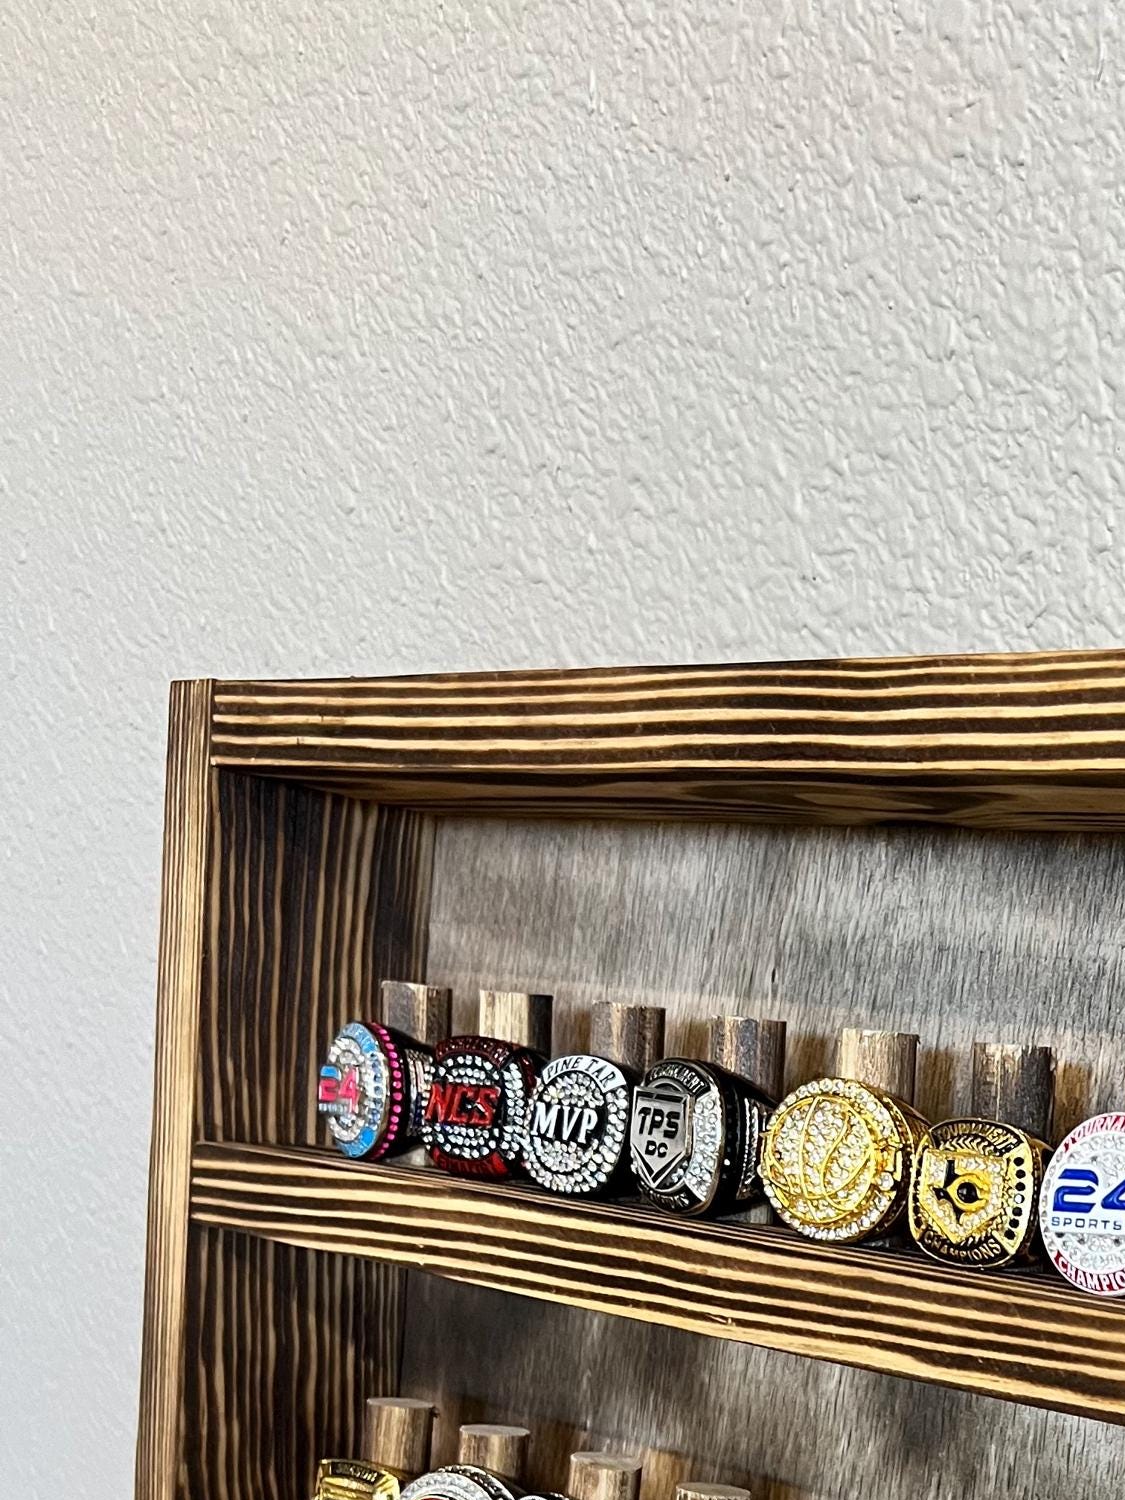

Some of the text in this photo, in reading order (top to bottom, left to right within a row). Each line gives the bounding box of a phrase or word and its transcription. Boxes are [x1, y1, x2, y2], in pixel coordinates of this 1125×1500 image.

[547, 1056, 617, 1090] PINE TAR
[424, 1081, 500, 1129] NCS
[638, 1105, 681, 1139] TPS
[530, 1101, 599, 1144] MVP
[644, 1139, 669, 1158] DC
[1051, 1216, 1123, 1231] SPORTS
[923, 1229, 1002, 1261] CHAMPIONS
